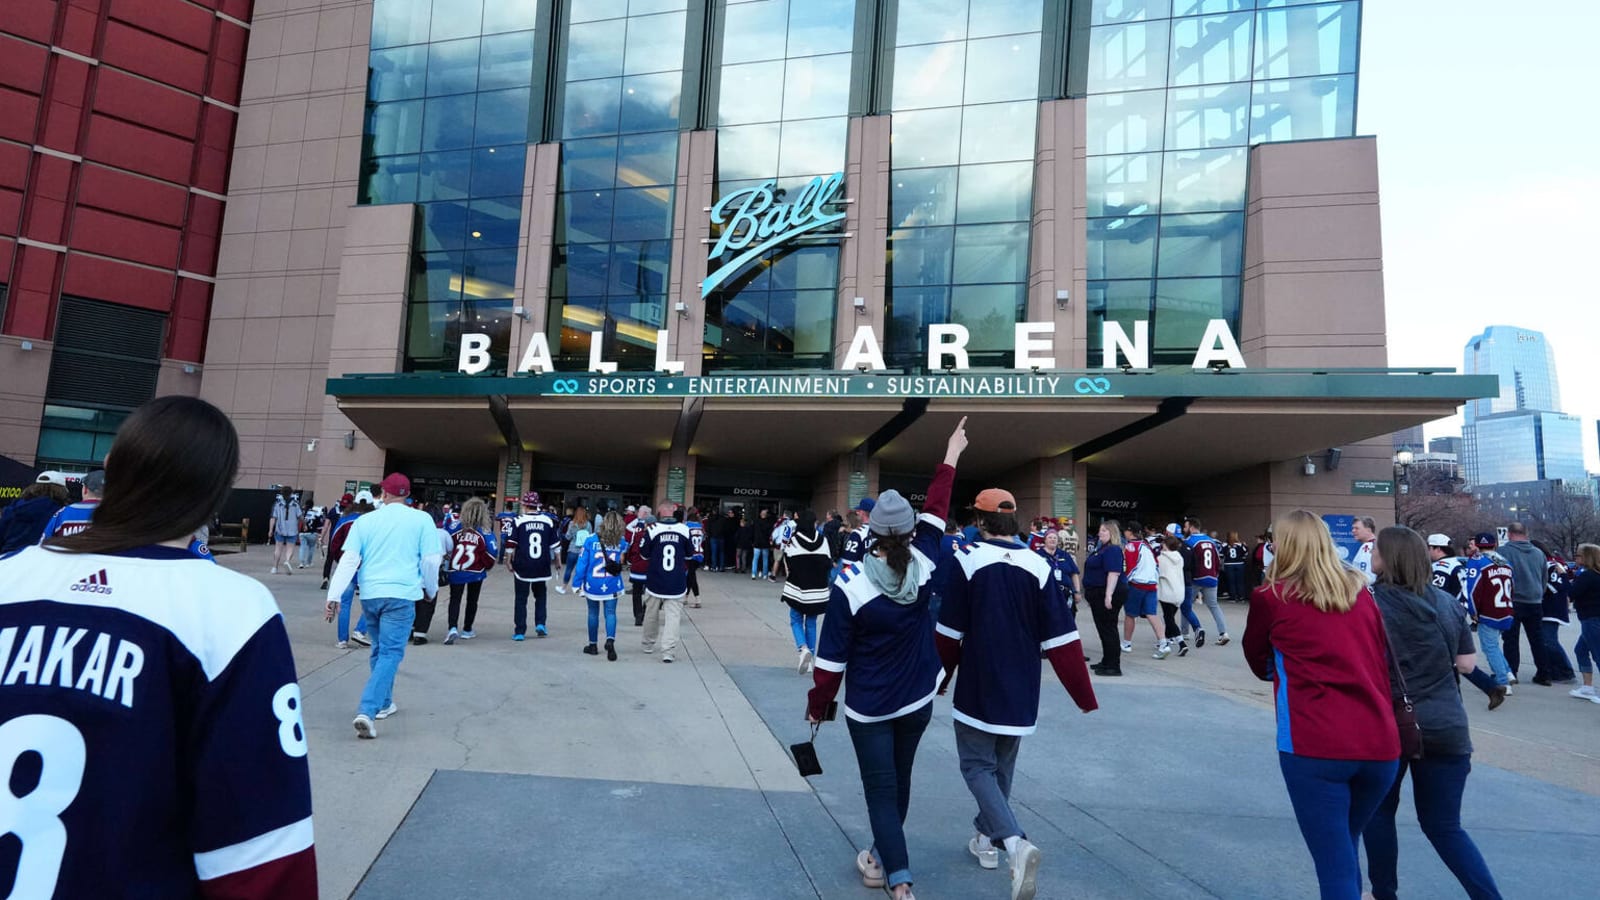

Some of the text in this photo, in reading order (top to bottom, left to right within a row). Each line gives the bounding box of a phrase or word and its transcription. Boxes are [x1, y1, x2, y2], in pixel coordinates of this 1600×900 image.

[707, 172, 846, 260] Ball
[458, 319, 1247, 374] BALL ARENA
[588, 377, 1061, 394] SPORTS ENTERTAINMENT SUSTAINABILITY
[733, 487, 760, 495] DOOR
[1101, 500, 1129, 508] DOOR
[525, 523, 544, 531] MAKAR
[528, 532, 542, 559] 8
[660, 534, 679, 543] MAKAR
[845, 541, 858, 553] 92
[452, 543, 476, 571] 23
[663, 545, 676, 571] 8
[1203, 549, 1212, 569] 8
[1229, 548, 1237, 558] 8
[70, 583, 112, 595] adidas
[1432, 574, 1446, 587] 29
[1491, 578, 1513, 608] 29
[272, 682, 308, 758] 8
